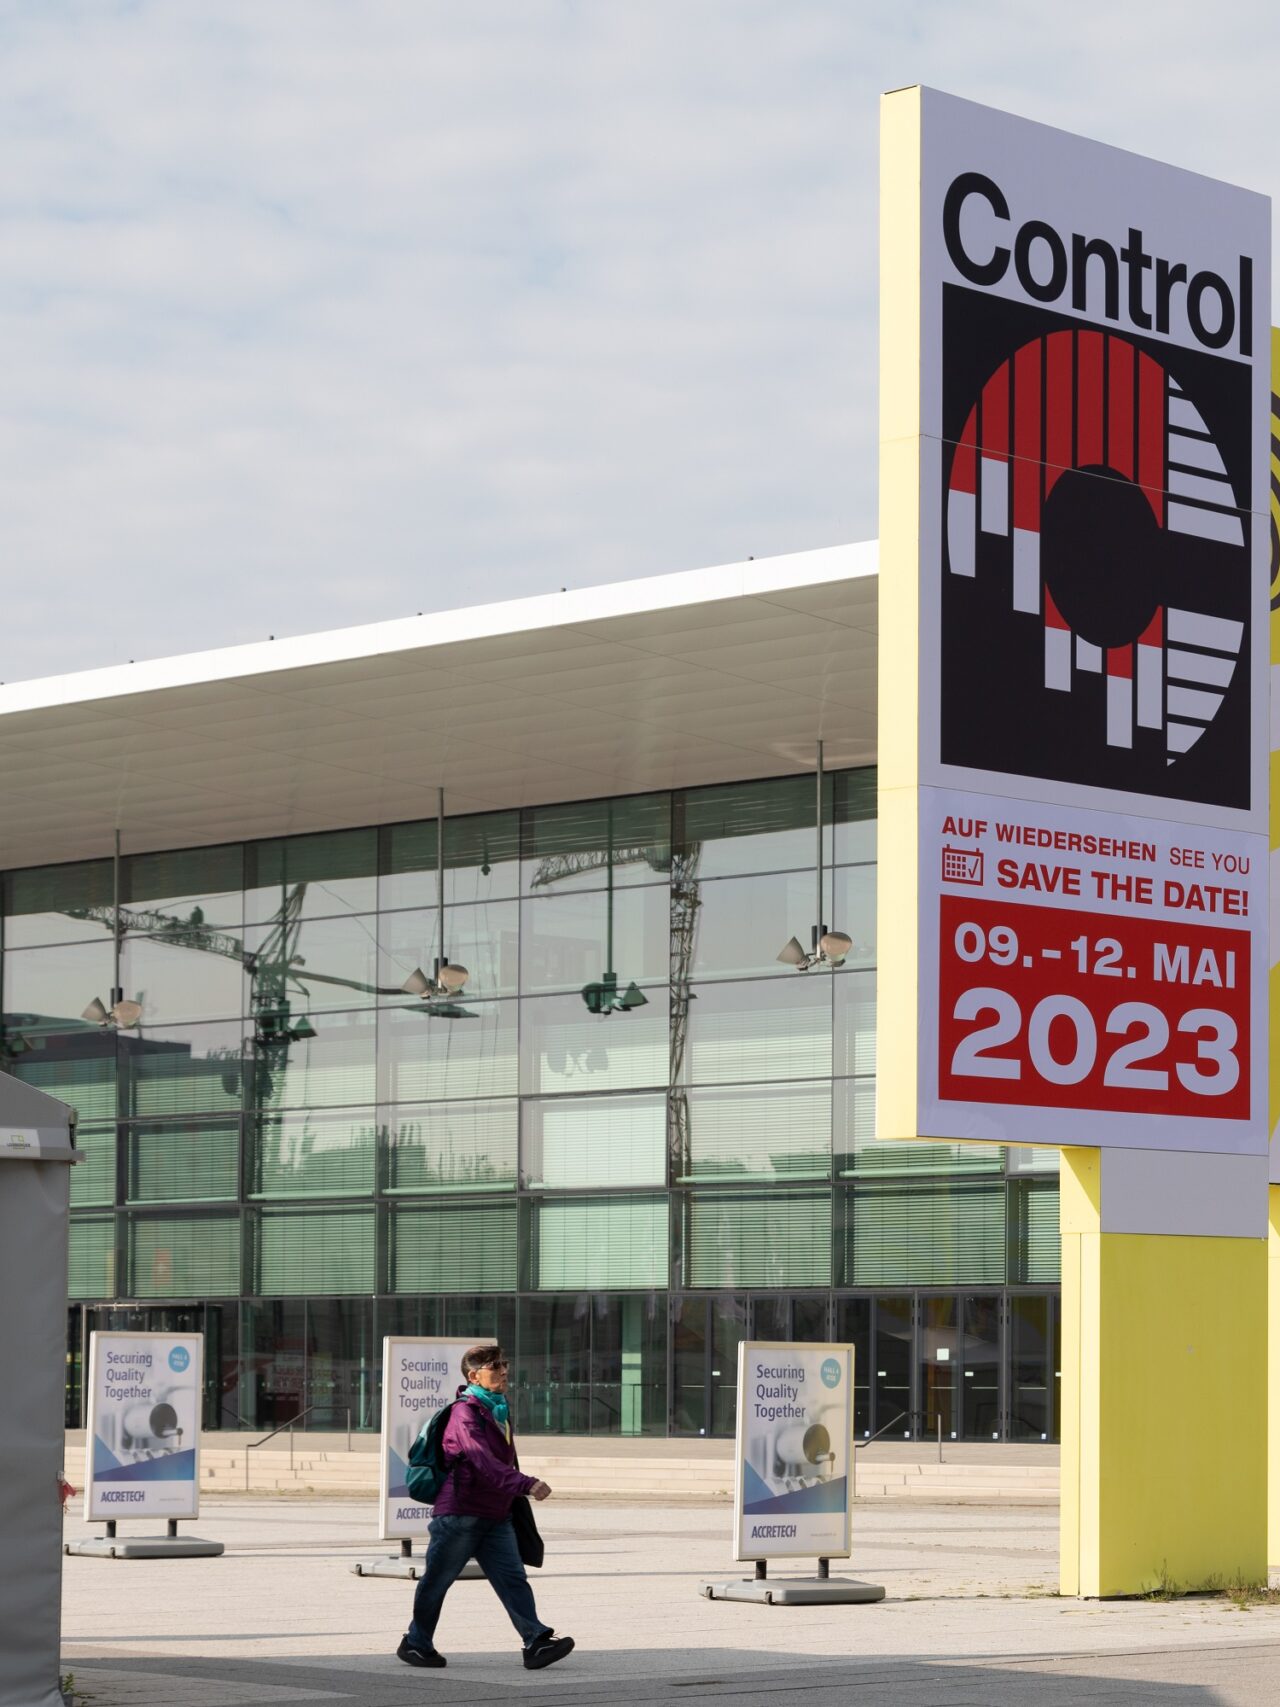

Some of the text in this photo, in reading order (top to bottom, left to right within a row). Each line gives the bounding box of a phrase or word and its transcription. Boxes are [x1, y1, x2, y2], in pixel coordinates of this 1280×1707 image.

[943, 171, 1253, 357] Control
[942, 816, 1250, 874] AUF WIEDERSEHEN SEE YOU
[997, 859, 1249, 917] SAVE THE DATE!
[1153, 942, 1236, 989] MAI
[950, 986, 1240, 1096] 2023
[106, 1351, 153, 1368] Securing
[401, 1358, 448, 1376] Securing
[106, 1368, 145, 1385] Quality
[756, 1364, 805, 1383] Securing
[104, 1385, 153, 1402] Together
[400, 1376, 442, 1393] Quality
[756, 1383, 799, 1402] Quality
[398, 1394, 449, 1412] Together
[754, 1402, 807, 1422] Together
[100, 1490, 145, 1503] ACCRETECH
[751, 1525, 797, 1539] ACCRETECH
